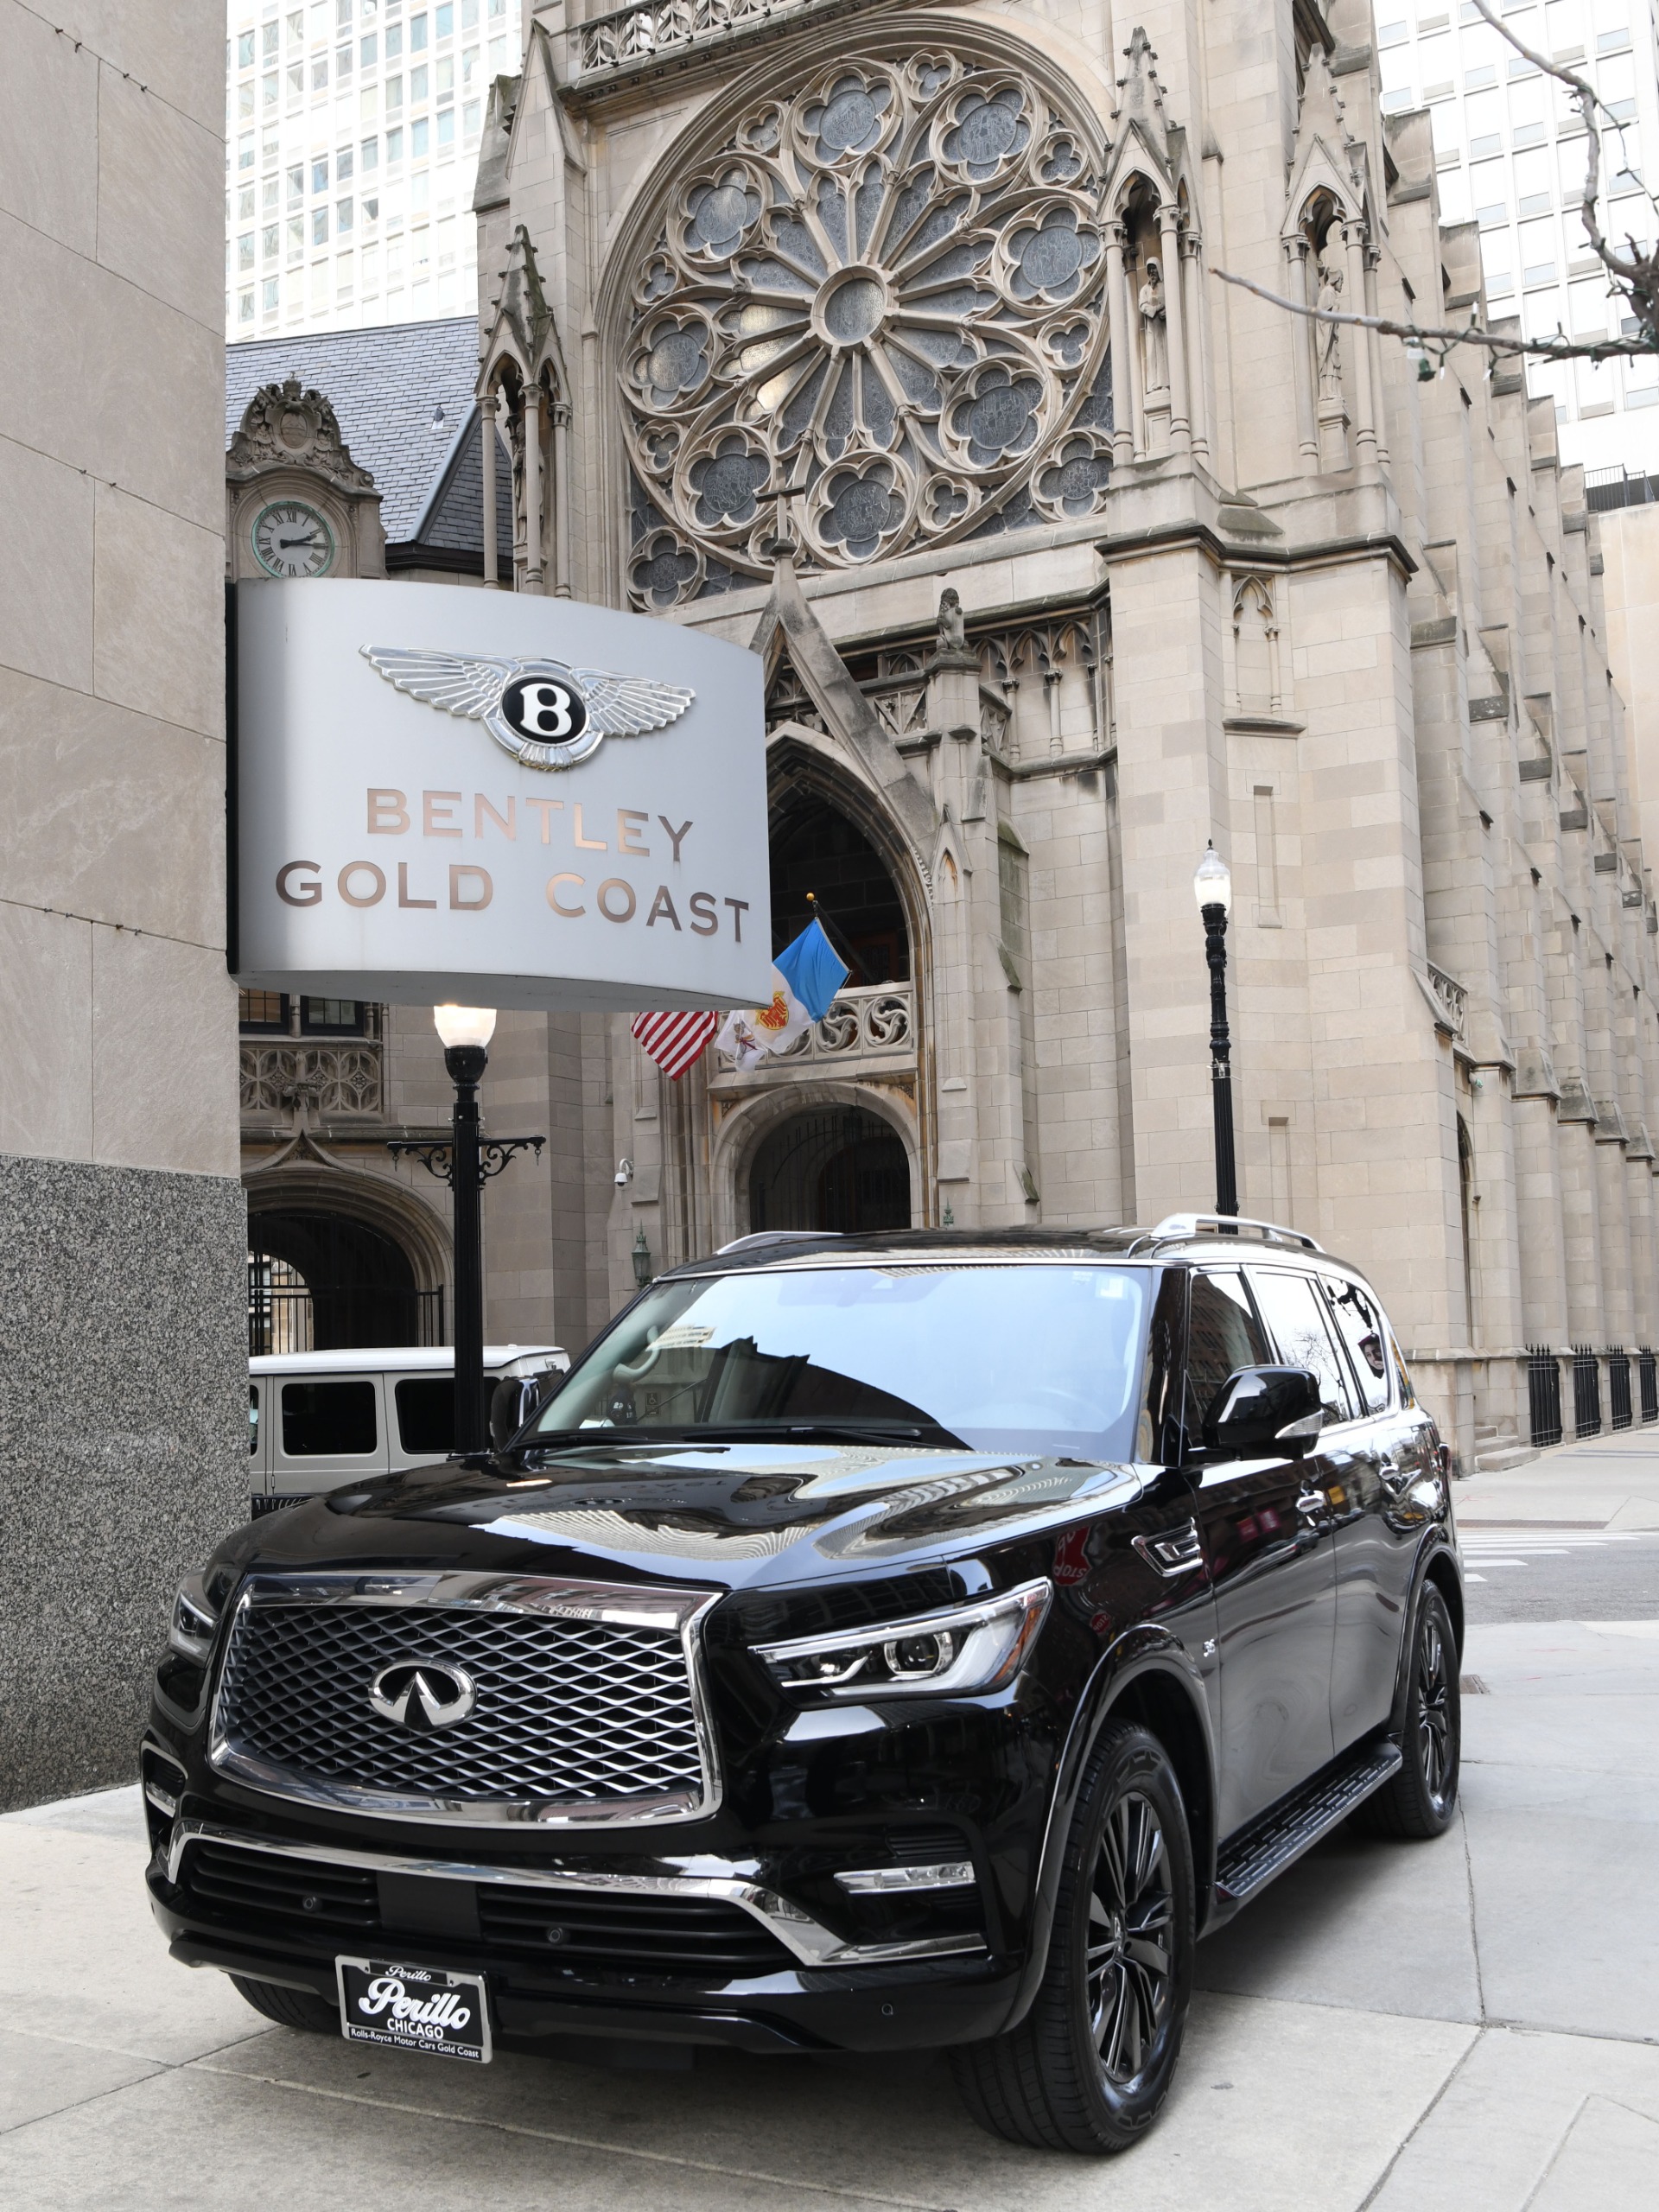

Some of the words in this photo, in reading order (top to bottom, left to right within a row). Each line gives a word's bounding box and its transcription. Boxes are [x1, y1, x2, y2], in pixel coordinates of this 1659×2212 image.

[286, 511, 297, 523] XII
[519, 683, 574, 737] B
[367, 788, 694, 863] BENTLEY
[275, 860, 493, 911] GOLD
[546, 872, 750, 943] COAST
[385, 1965, 432, 1982] Perillo
[358, 1977, 471, 2030] Perillo
[351, 2029, 392, 2044] Rolls-Royce
[394, 2035, 416, 2047] Motor
[418, 2039, 435, 2050] Cars
[437, 2043, 455, 2055] Gold
[457, 2046, 480, 2058] Coast
[387, 2018, 443, 2040] CHICAGO
